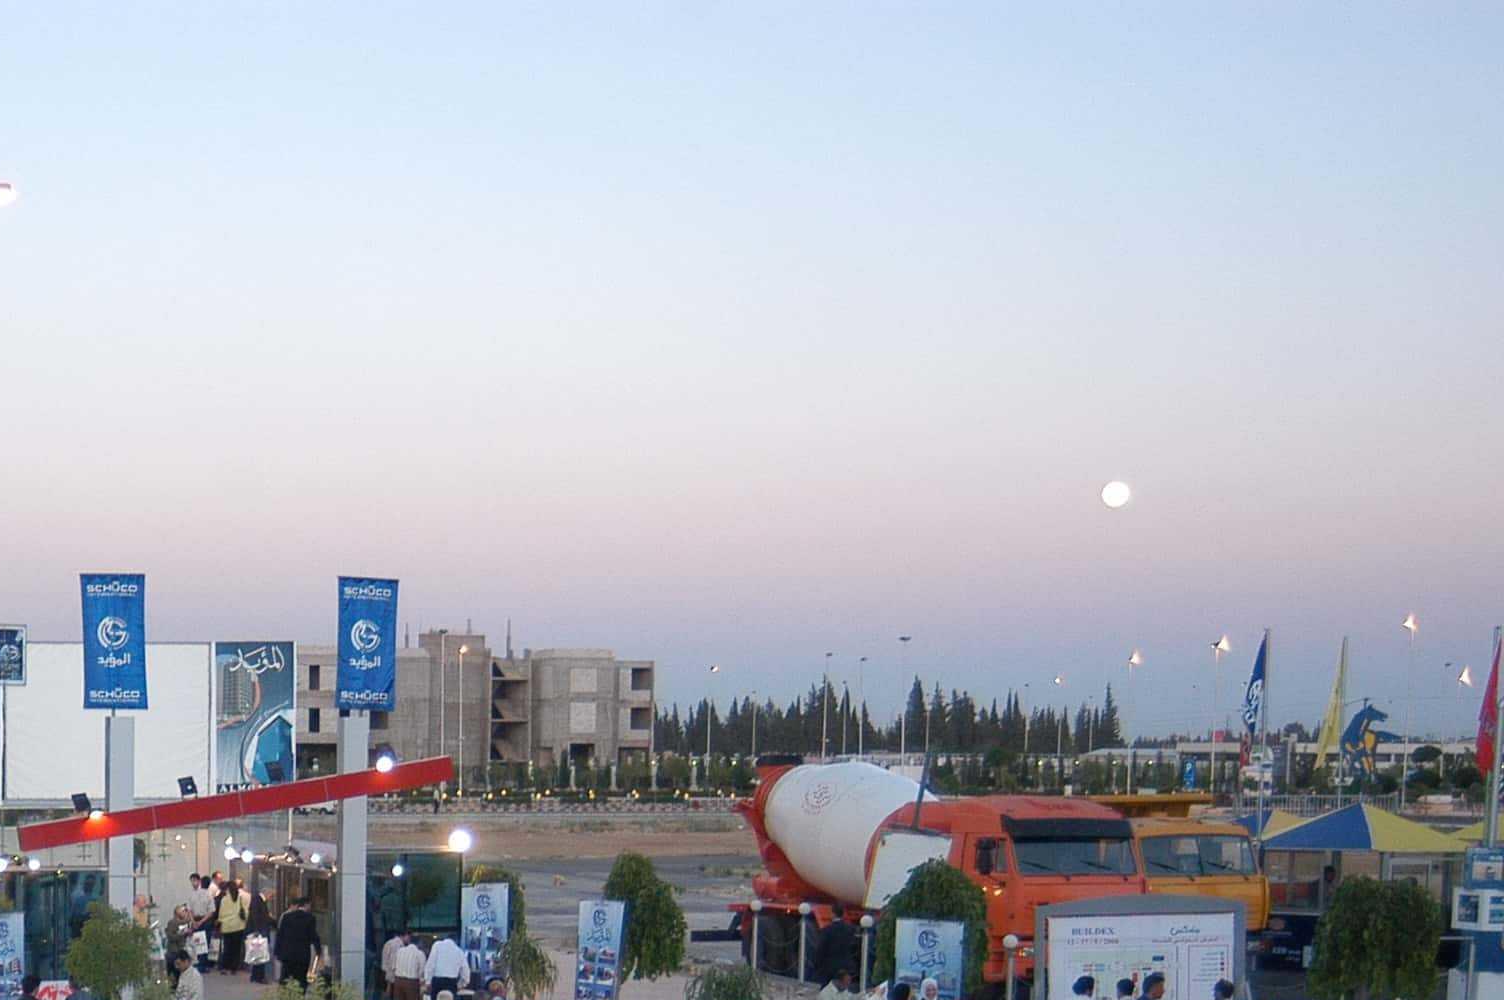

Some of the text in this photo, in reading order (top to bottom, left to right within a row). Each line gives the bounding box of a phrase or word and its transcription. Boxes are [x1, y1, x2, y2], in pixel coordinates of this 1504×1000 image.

[87, 581, 137, 593] SCHÜCO
[344, 585, 392, 597] SCHÜCO
[98, 652, 131, 668] المؤيد
[349, 655, 381, 670] المؤيد
[89, 687, 140, 698] SCHÜCO
[340, 690, 388, 700] SCHÜCO
[1071, 927, 1114, 936] BUILDEX
